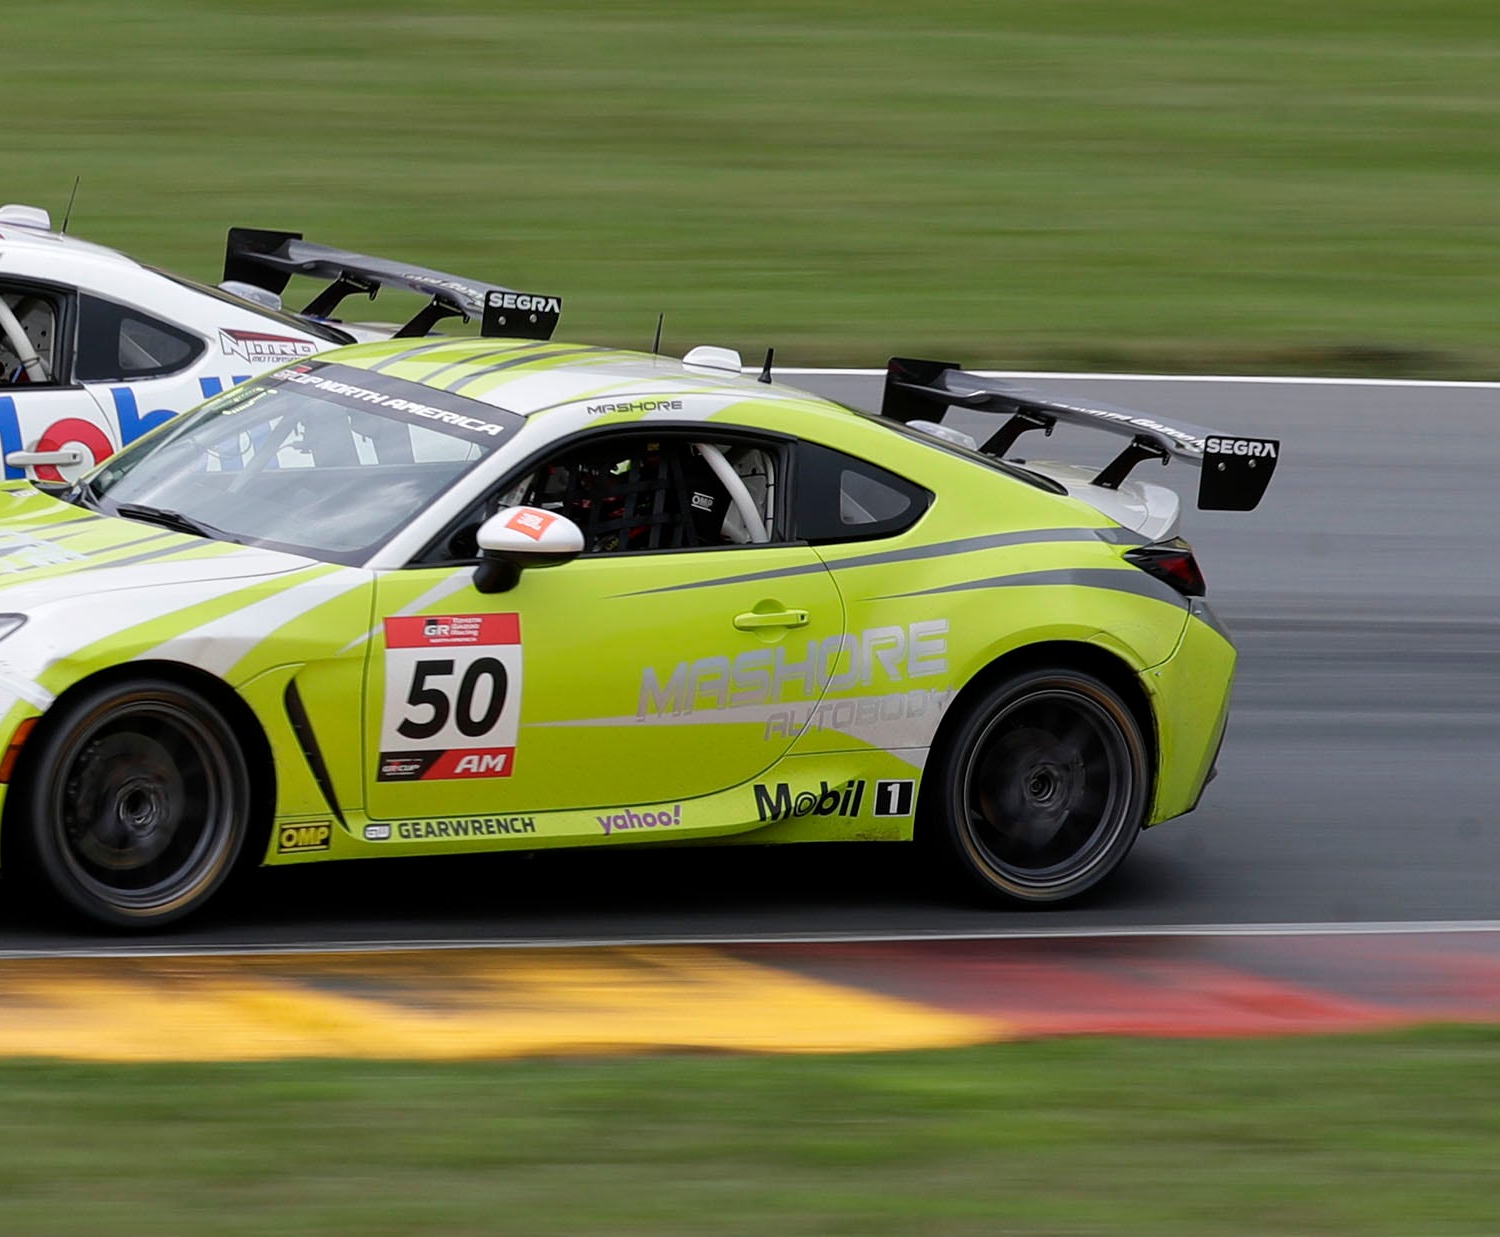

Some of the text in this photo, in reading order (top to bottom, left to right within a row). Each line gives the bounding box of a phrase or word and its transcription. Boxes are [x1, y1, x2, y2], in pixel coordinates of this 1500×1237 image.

[489, 292, 560, 313] SEGRA
[315, 380, 389, 403] NORTH
[381, 399, 504, 436] AMERICA
[586, 400, 683, 414] MASHORE
[1206, 438, 1277, 458] SEGRA
[691, 495, 713, 508] OMP
[424, 625, 450, 636] GR
[637, 618, 949, 722] MASHORE
[396, 657, 508, 739] 50
[454, 754, 507, 774] AM
[754, 780, 865, 822] Mobil
[399, 817, 535, 839] GEARWRENCH
[596, 805, 681, 836] yahoo!
[280, 826, 329, 848] OMP
